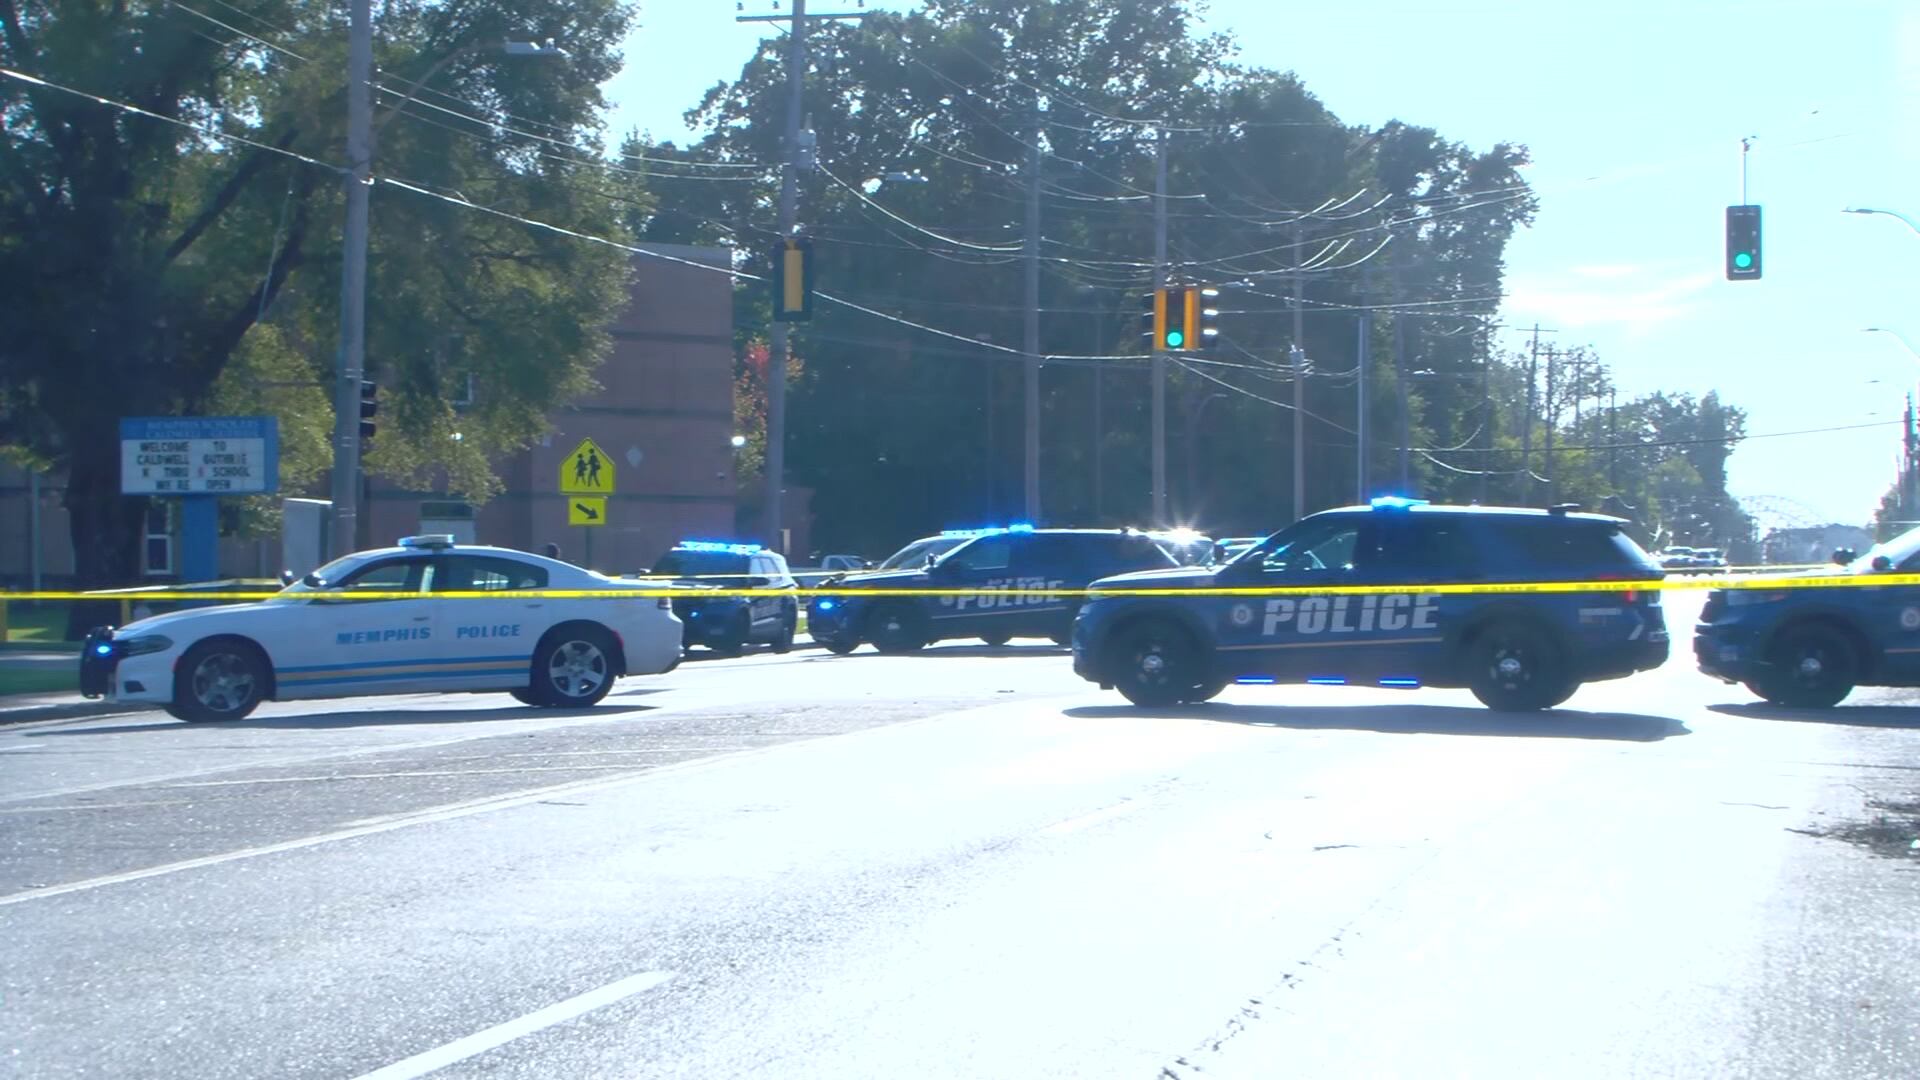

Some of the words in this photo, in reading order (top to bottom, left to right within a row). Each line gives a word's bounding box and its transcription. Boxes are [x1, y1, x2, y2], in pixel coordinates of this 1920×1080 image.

[140, 442, 189, 452] WELCOME
[213, 441, 227, 451] TO
[136, 454, 189, 465] CALDWELL
[203, 454, 247, 464] GUTHRIE
[164, 467, 189, 477] THRU
[213, 467, 250, 477] SCHOOL
[206, 480, 231, 489] OPEN
[957, 580, 1064, 609] POLICE
[1262, 593, 1442, 635] POLICE
[336, 627, 431, 645] MEMPHIS
[456, 624, 521, 639] POLICE
